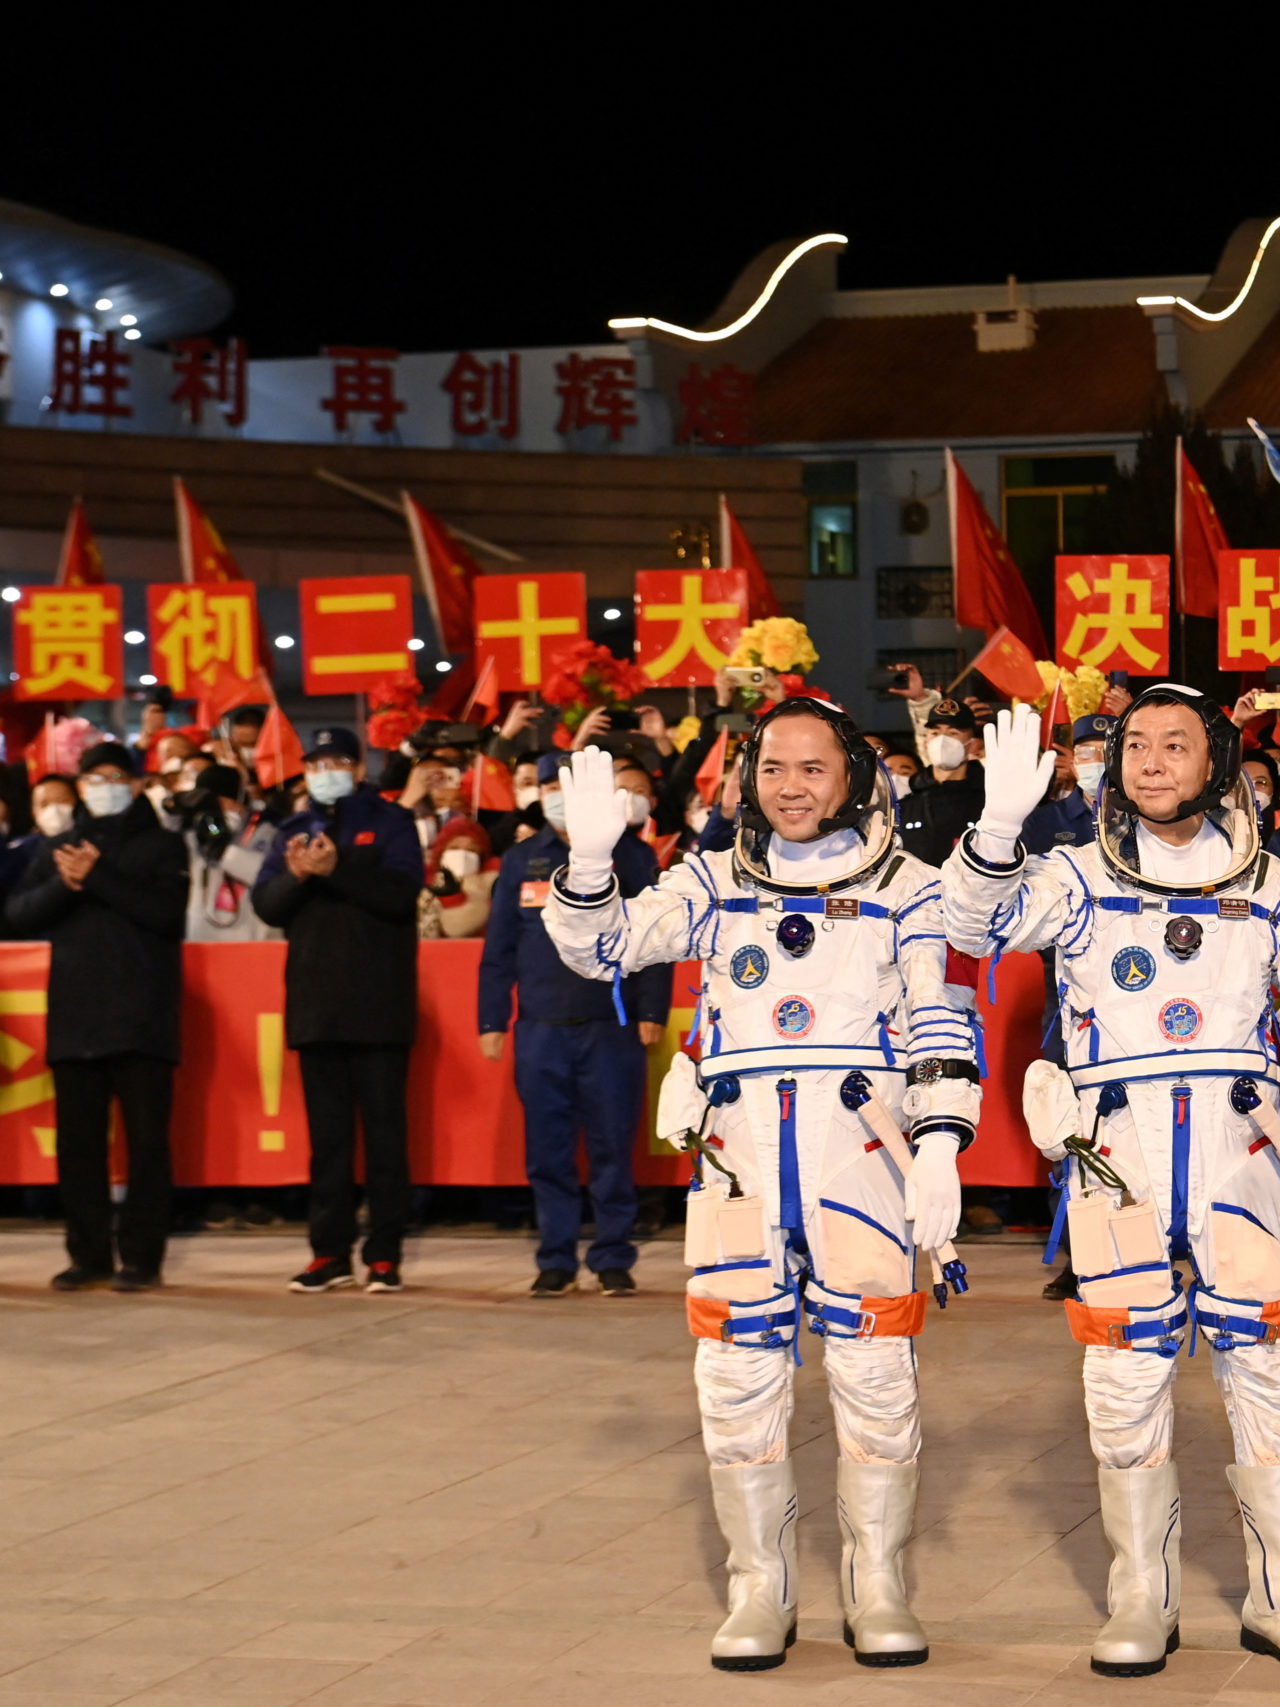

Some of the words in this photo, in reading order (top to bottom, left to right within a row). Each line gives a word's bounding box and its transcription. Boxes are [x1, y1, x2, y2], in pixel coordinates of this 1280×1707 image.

[0, 328, 249, 427] 胜利
[18, 575, 739, 693] 贯彻二十大
